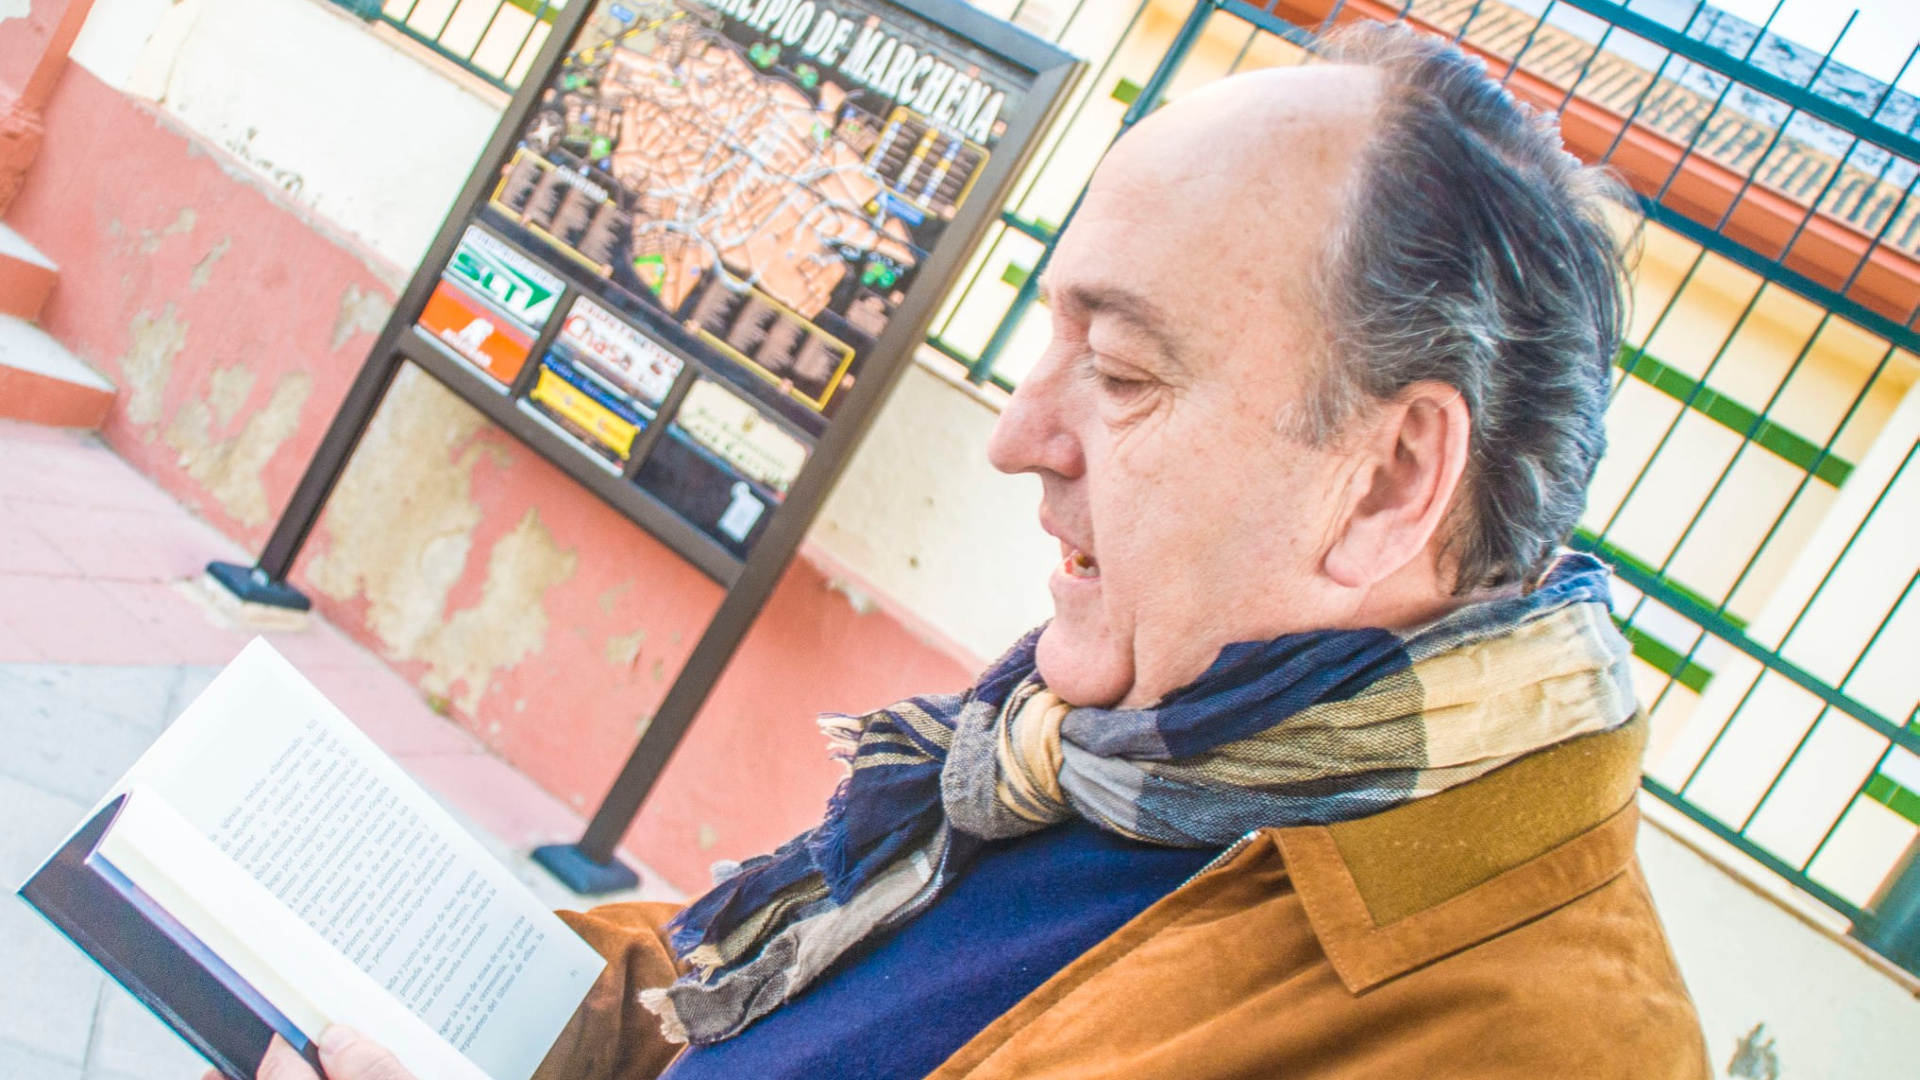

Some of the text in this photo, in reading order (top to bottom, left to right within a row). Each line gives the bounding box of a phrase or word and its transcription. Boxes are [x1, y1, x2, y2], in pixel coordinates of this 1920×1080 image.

[801, 10, 855, 66] DE
[838, 26, 1005, 145] MARCHENA
[290, 821, 304, 835] de
[347, 755, 360, 768] de
[267, 825, 281, 840] de
[313, 839, 326, 853] de
[351, 859, 364, 873] de
[369, 860, 381, 873] de
[365, 887, 377, 901] de
[421, 883, 433, 896] de
[435, 909, 447, 923] de
[421, 951, 433, 965] de
[467, 979, 479, 993] de
[488, 951, 499, 964] de
[513, 961, 524, 974] de
